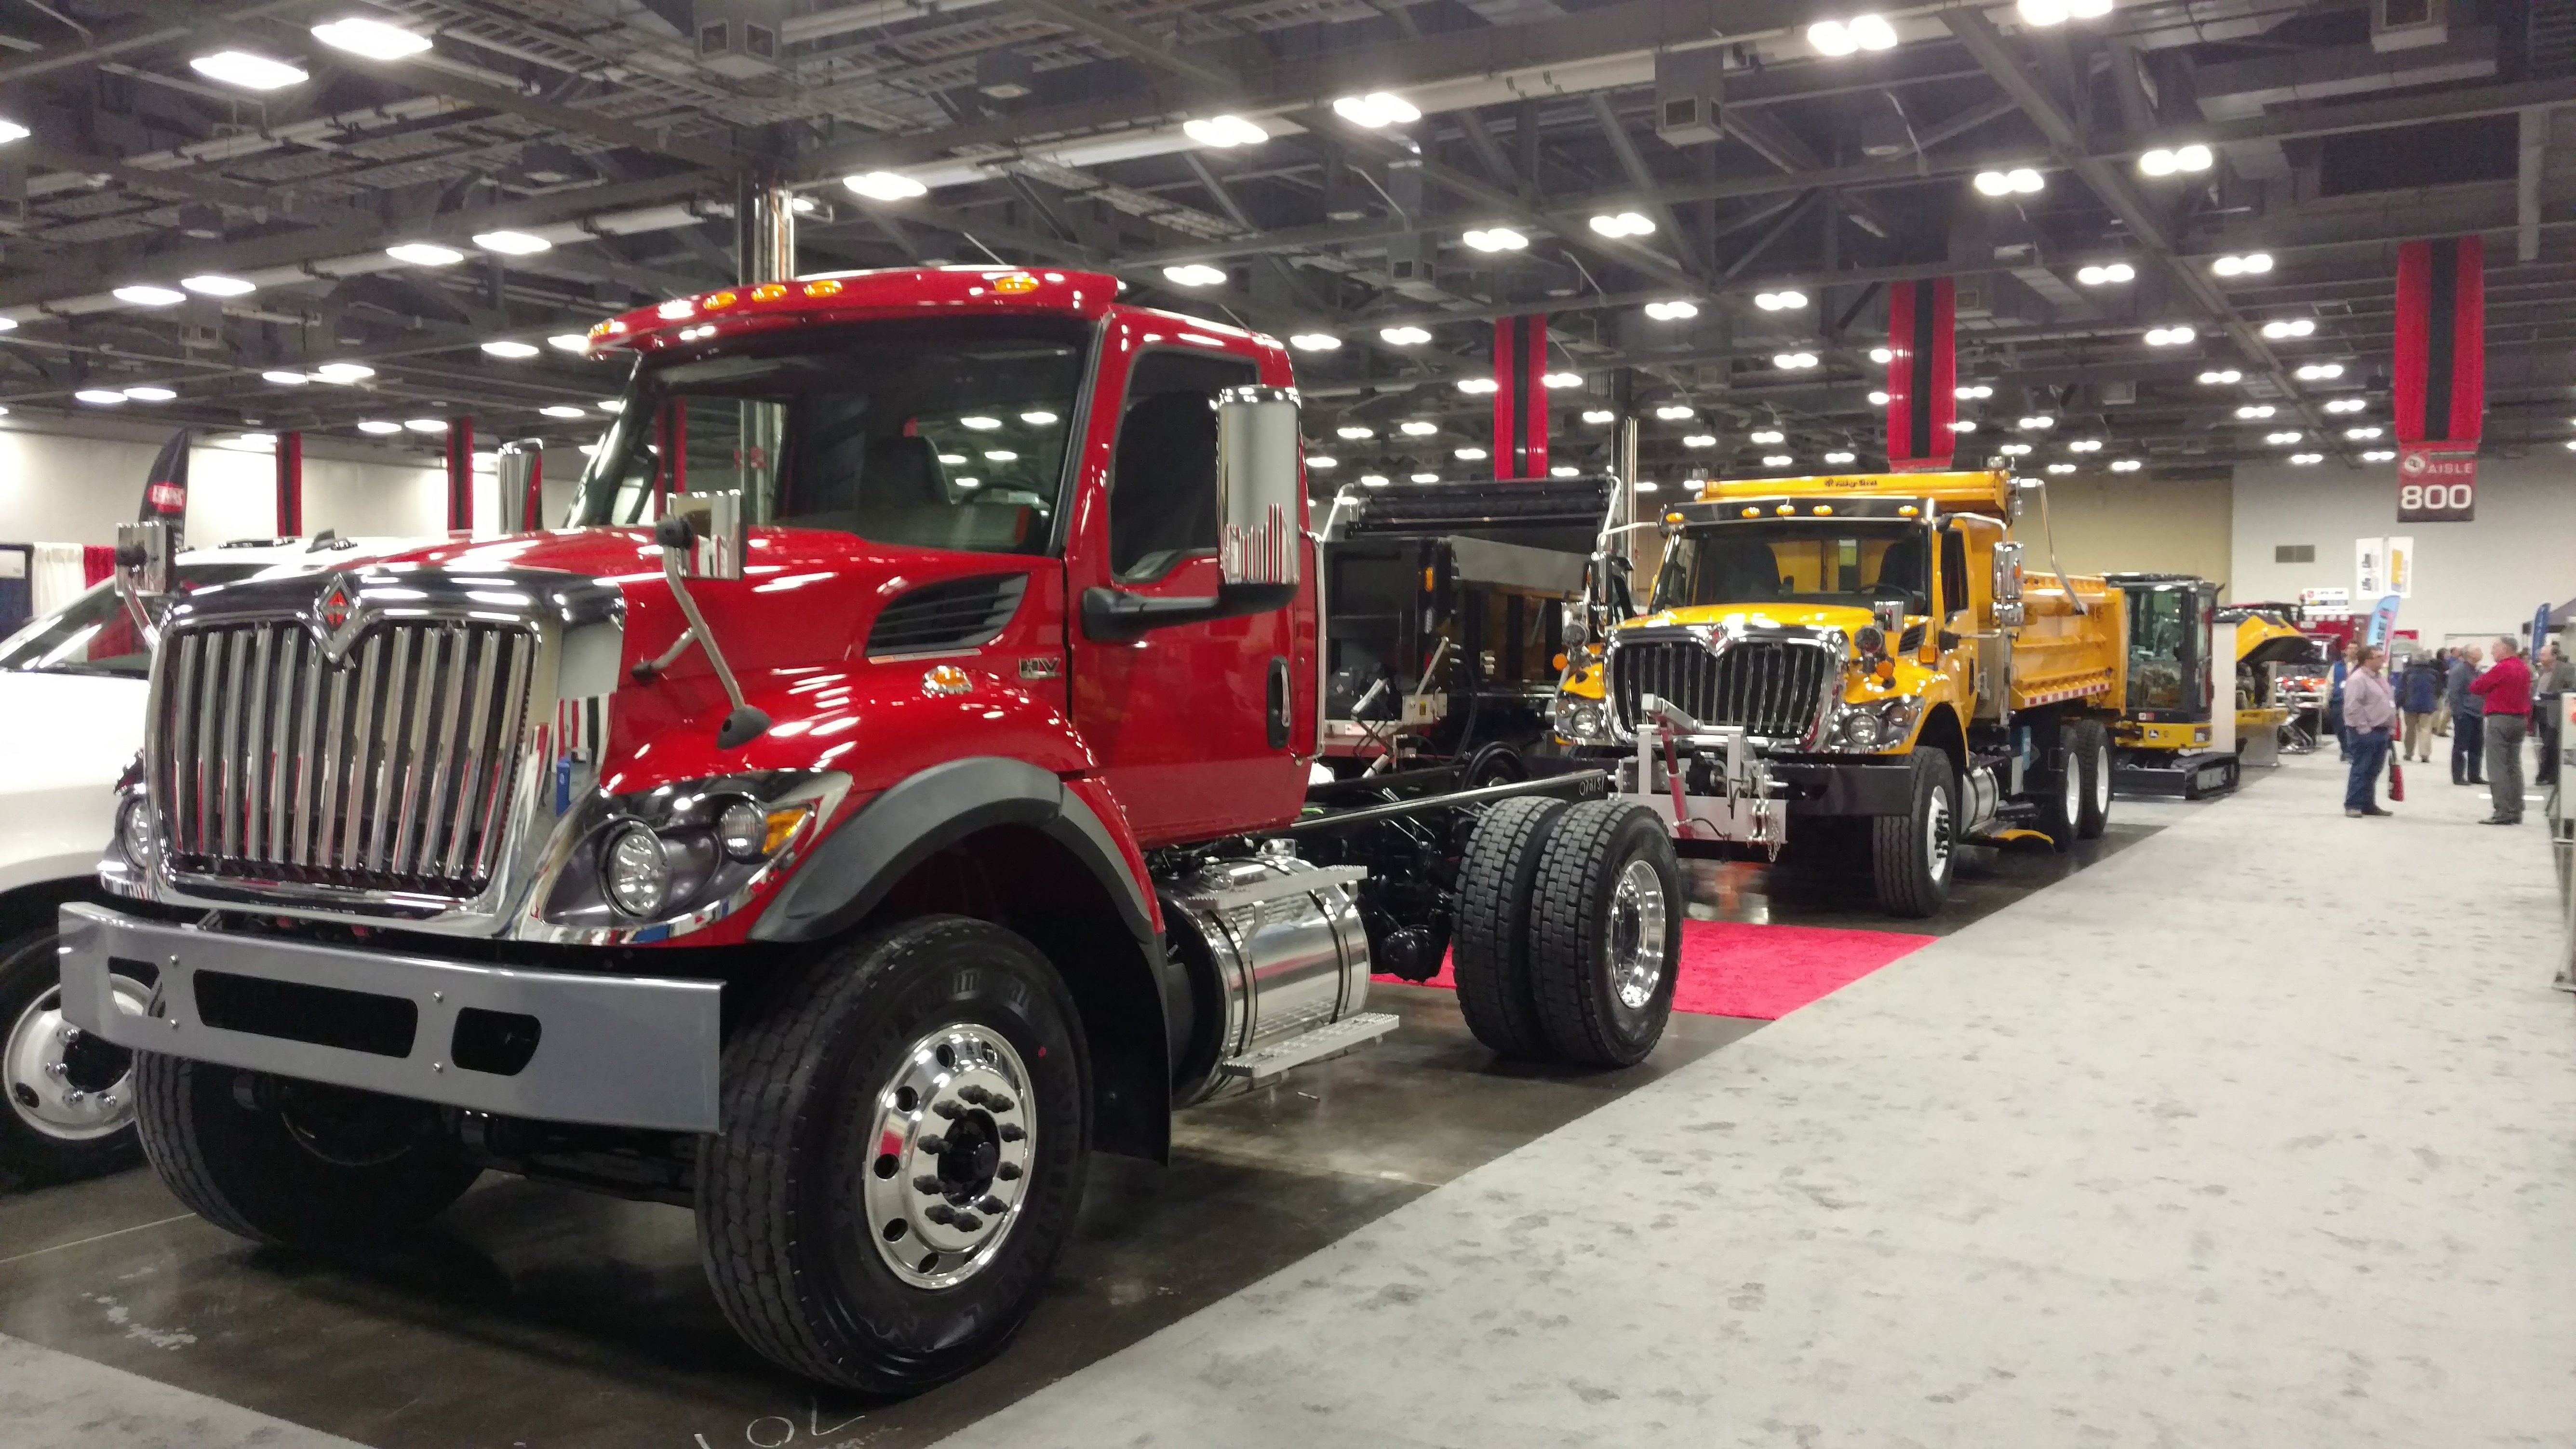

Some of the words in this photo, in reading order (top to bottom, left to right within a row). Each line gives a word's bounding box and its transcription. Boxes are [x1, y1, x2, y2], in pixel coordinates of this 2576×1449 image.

[2428, 463, 2473, 474] AISLE
[2401, 484, 2472, 510] 800
[1018, 657, 1062, 678] HV
